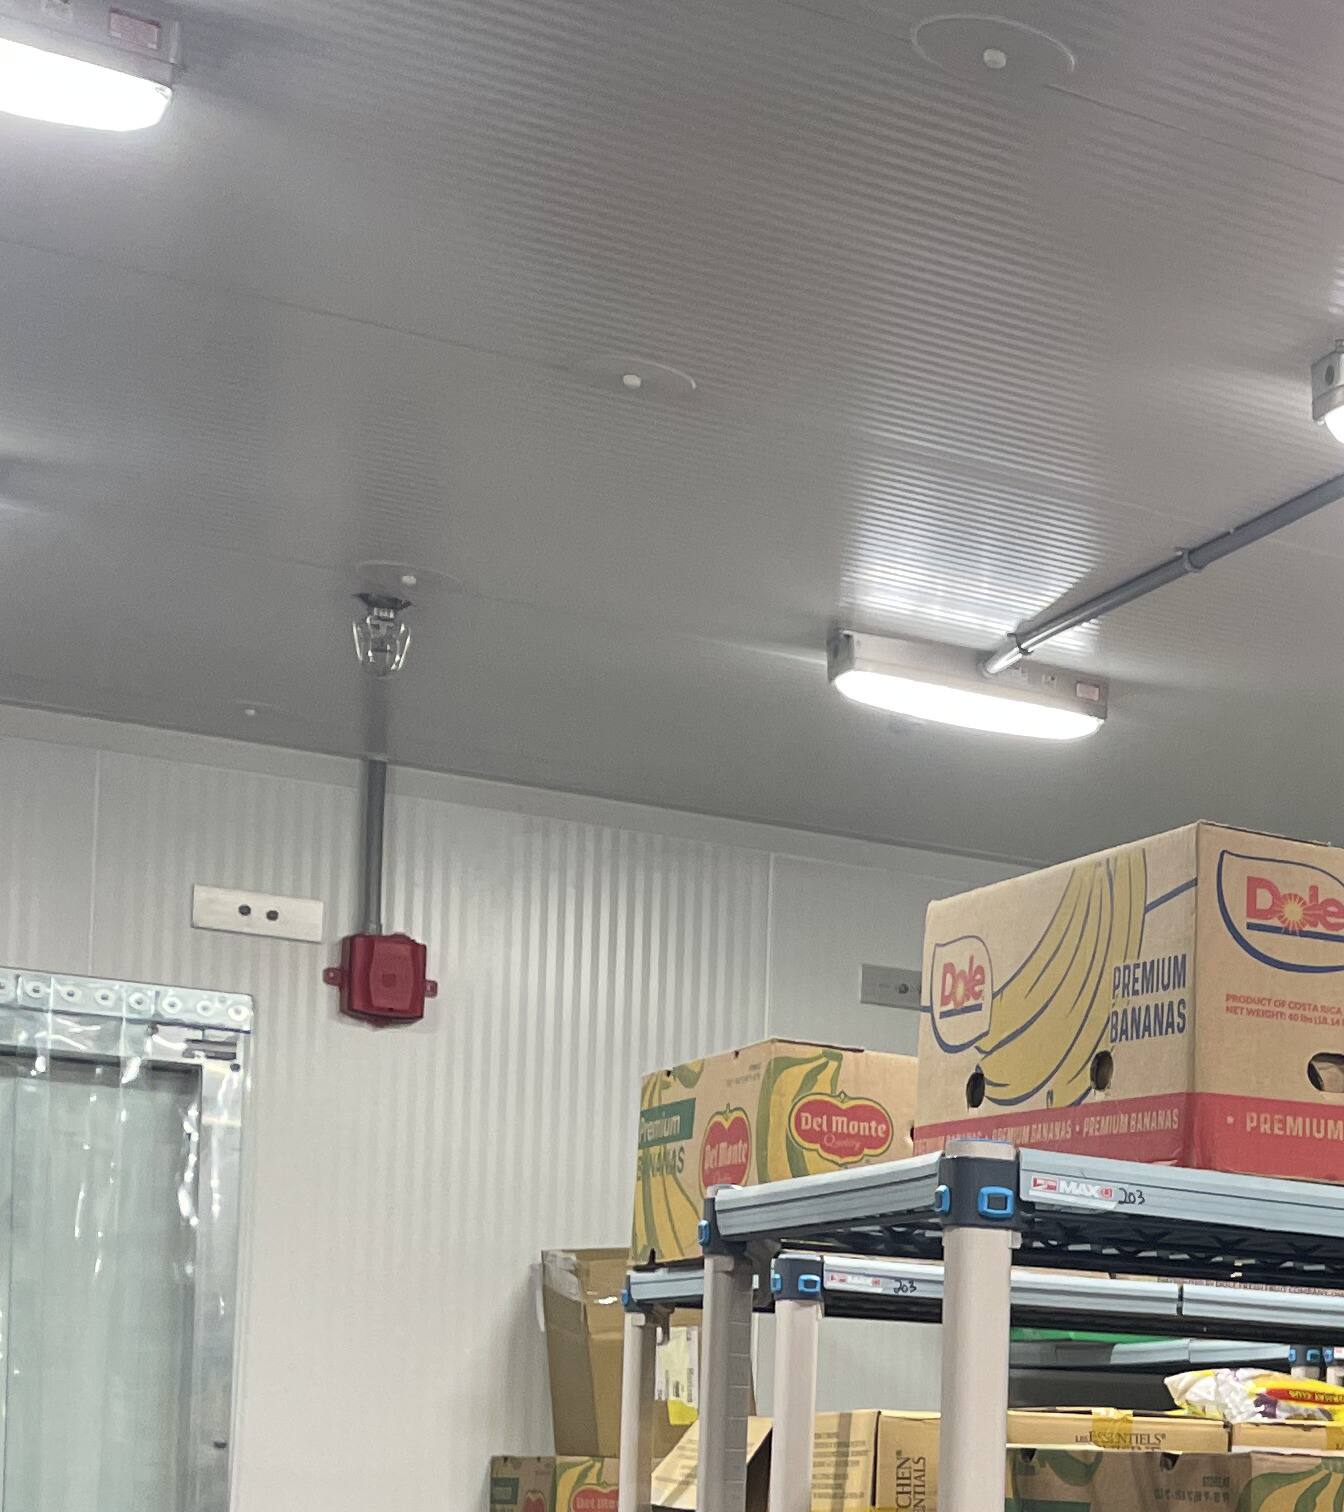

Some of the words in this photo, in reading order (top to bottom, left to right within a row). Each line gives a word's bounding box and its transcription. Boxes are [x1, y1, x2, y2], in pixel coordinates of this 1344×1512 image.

[940, 954, 985, 1009] Dole
[1112, 953, 1187, 999] PREMIUM
[1226, 993, 1272, 1008] PRODUCT
[1274, 999, 1286, 1009] OF
[1288, 1000, 1319, 1013] COSTA
[1320, 1004, 1342, 1015] RICA
[1226, 1006, 1245, 1017] NET
[1109, 998, 1186, 1044] BANANAS
[800, 1112, 828, 1133] Del
[831, 1115, 887, 1138] Monte
[1030, 1121, 1072, 1143] BANANAS
[1083, 1114, 1128, 1137] PREMIUM
[1129, 1109, 1179, 1131] BANANAS
[1245, 1111, 1344, 1142] PREMIUM
[1118, 1187, 1146, 1205] 203
